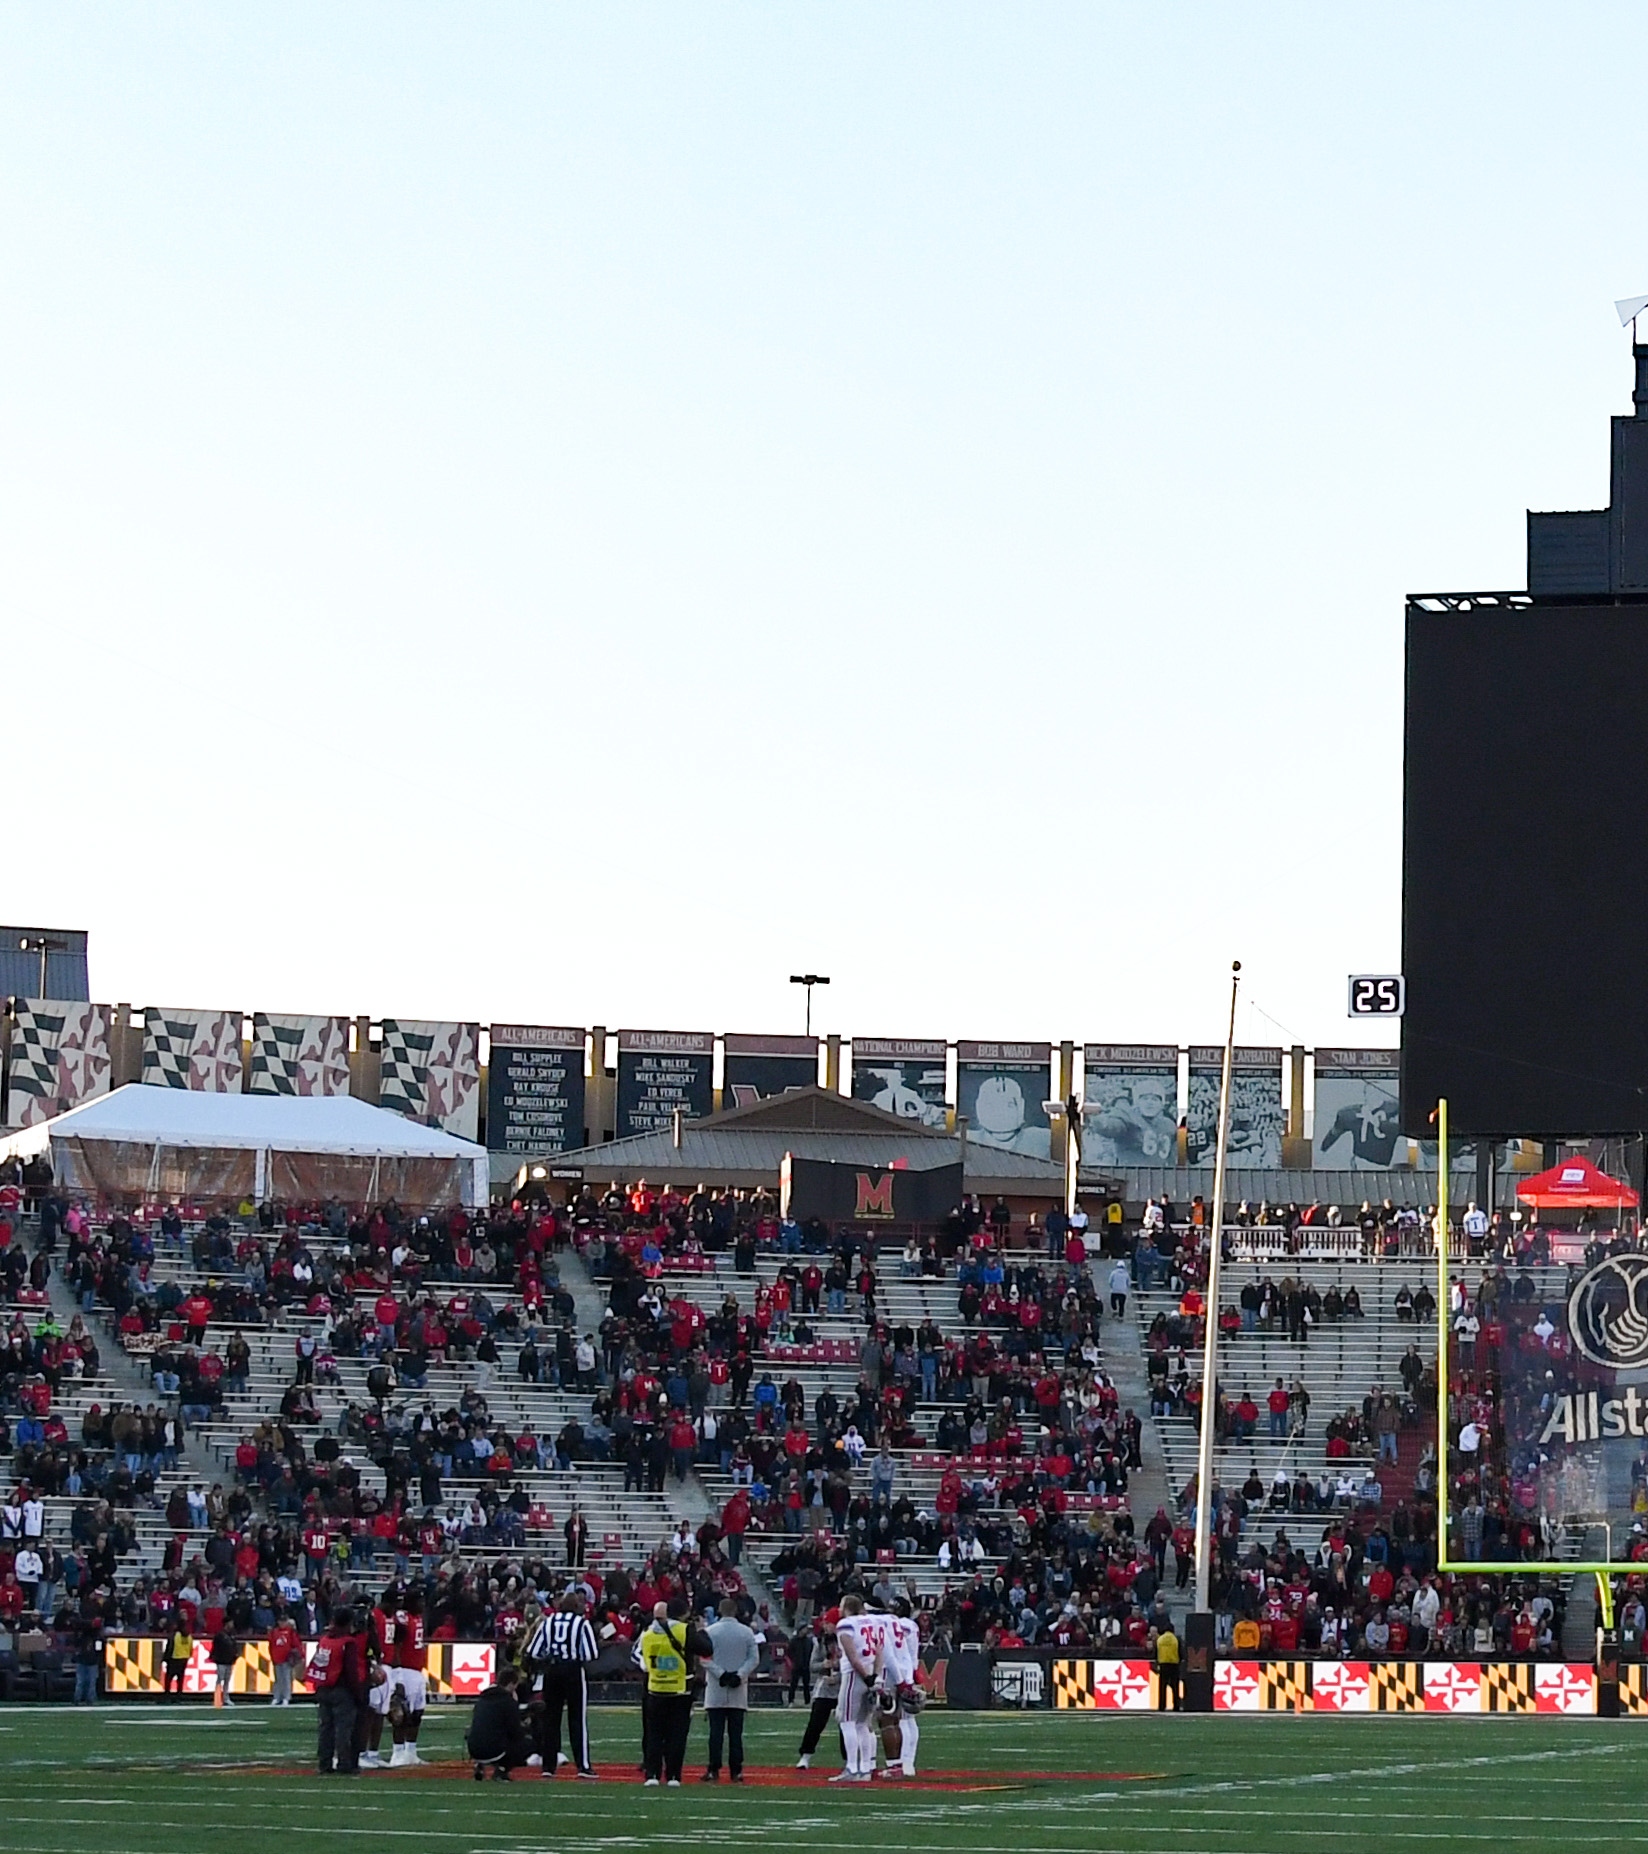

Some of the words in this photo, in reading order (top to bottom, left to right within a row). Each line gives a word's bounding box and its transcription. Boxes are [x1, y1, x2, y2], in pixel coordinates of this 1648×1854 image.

[1356, 980, 1396, 1011] 25
[502, 1028, 576, 1043] ALL-AMERICANS
[629, 1034, 704, 1048] ALL-AMERICANS
[853, 1040, 894, 1053] NATIONAL
[896, 1042, 946, 1054] CHAMPIONS
[978, 1044, 998, 1057] BOB
[1003, 1045, 1032, 1058] WARD
[1194, 1049, 1221, 1062] JACK
[1232, 1050, 1277, 1063] CARBATH
[1332, 1052, 1356, 1064] STAN
[1360, 1052, 1391, 1065] JONES
[552, 1170, 582, 1179] WOMEN
[855, 1173, 895, 1214] M
[311, 1534, 326, 1550] 10
[553, 1621, 570, 1643] U
